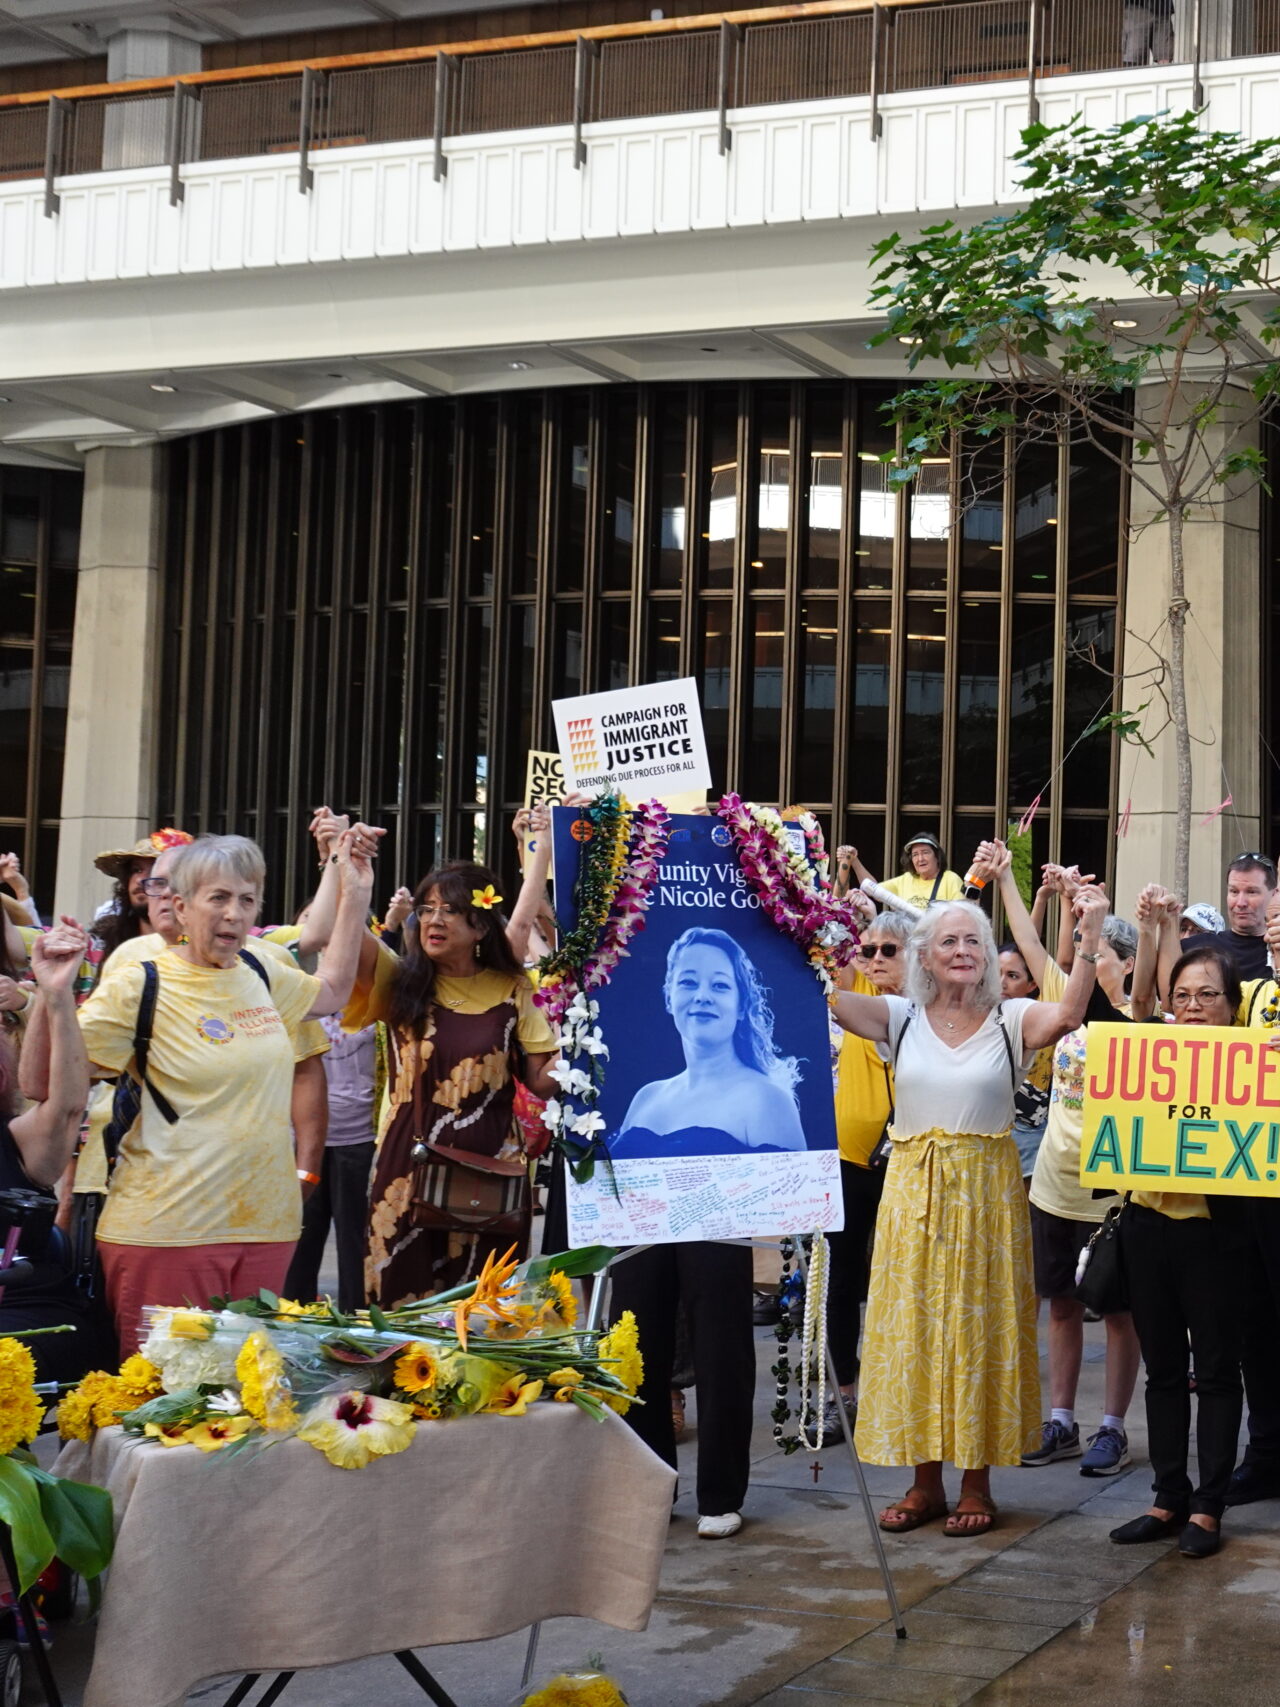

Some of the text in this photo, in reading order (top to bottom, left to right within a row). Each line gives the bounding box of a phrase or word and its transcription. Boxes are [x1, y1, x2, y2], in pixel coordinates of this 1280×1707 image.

[601, 702, 687, 728] CAMPAIGN FOR
[603, 718, 689, 748] IMMIGRANT
[606, 738, 693, 771] JUSTICE
[576, 760, 696, 789] DEFENDING DUE PROCESS FOR ALL
[656, 860, 711, 886] unity
[659, 885, 726, 908] Nicole
[731, 888, 765, 909] Go
[1168, 1105, 1211, 1120] FOR
[1085, 1115, 1280, 1181] ALEX!
